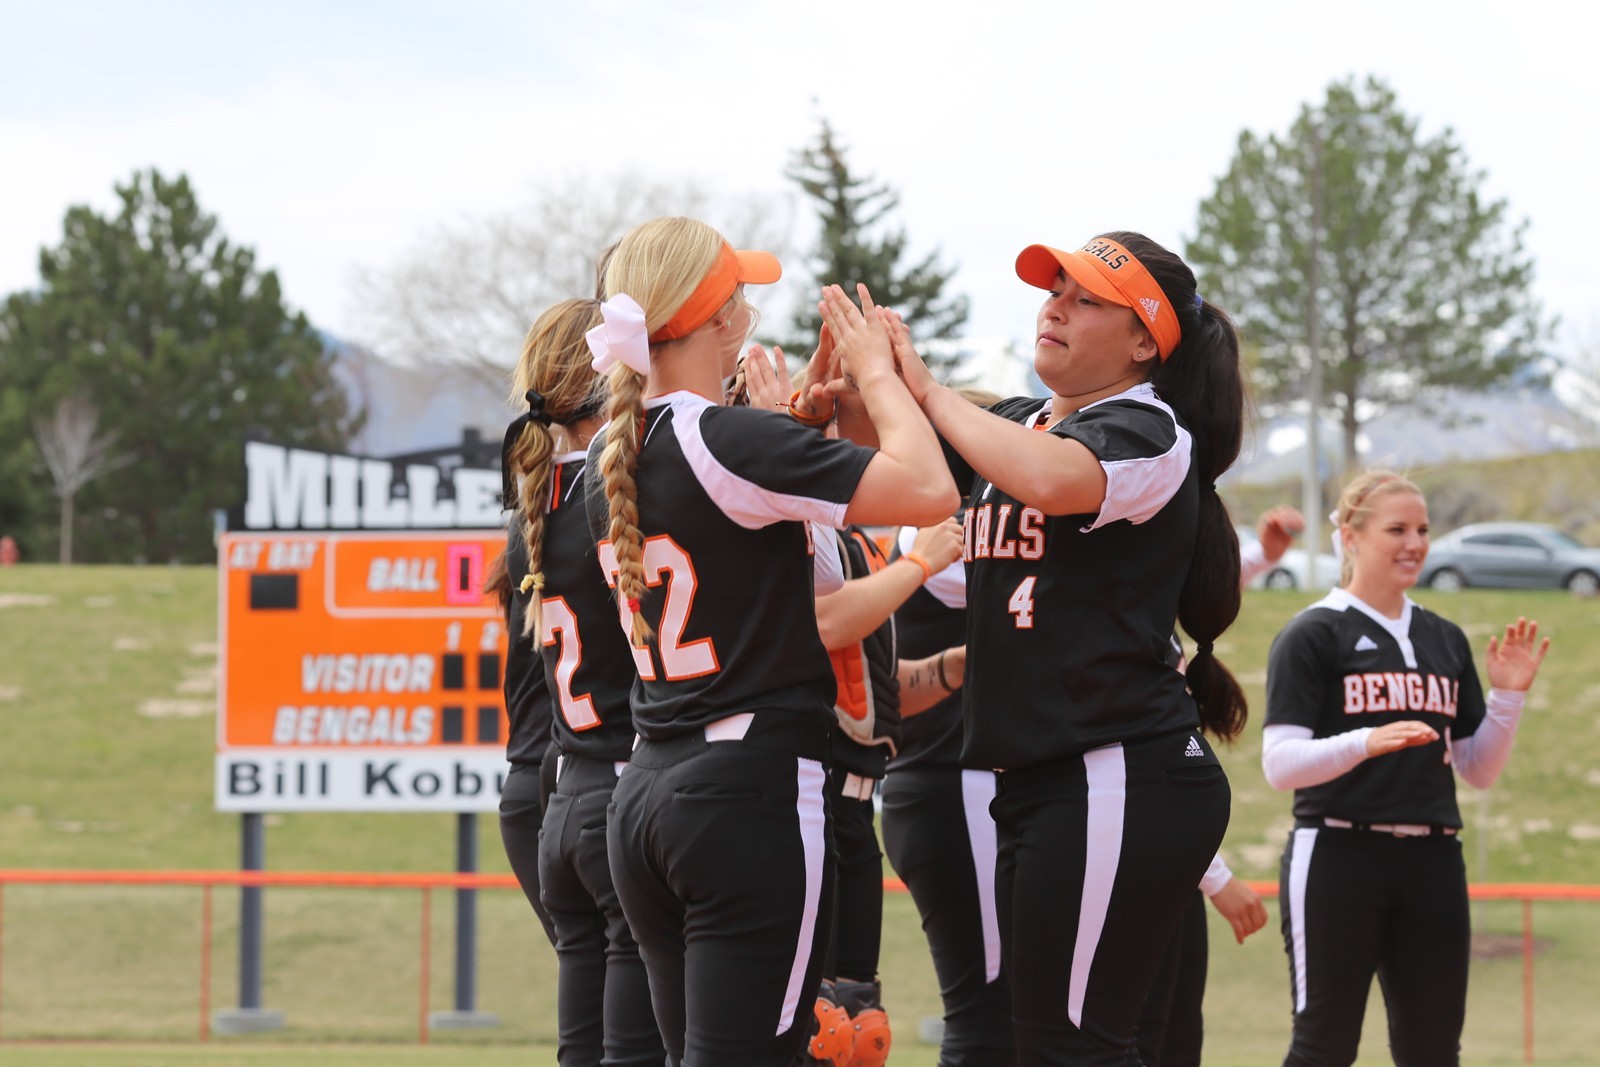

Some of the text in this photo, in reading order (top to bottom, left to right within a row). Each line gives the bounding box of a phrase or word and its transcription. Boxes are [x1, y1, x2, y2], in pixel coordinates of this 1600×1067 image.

[1082, 240, 1130, 270] GALS
[245, 440, 513, 529] MILLE
[229, 541, 318, 571] AT BAT
[366, 557, 440, 592] BALL
[1008, 576, 1038, 629] 4
[445, 621, 500, 650] 1 2
[302, 653, 435, 692] VISITOR
[541, 596, 602, 732] 2
[1343, 672, 1459, 718] BENGAL
[272, 705, 435, 745] BENGALS
[228, 761, 328, 797] Bill
